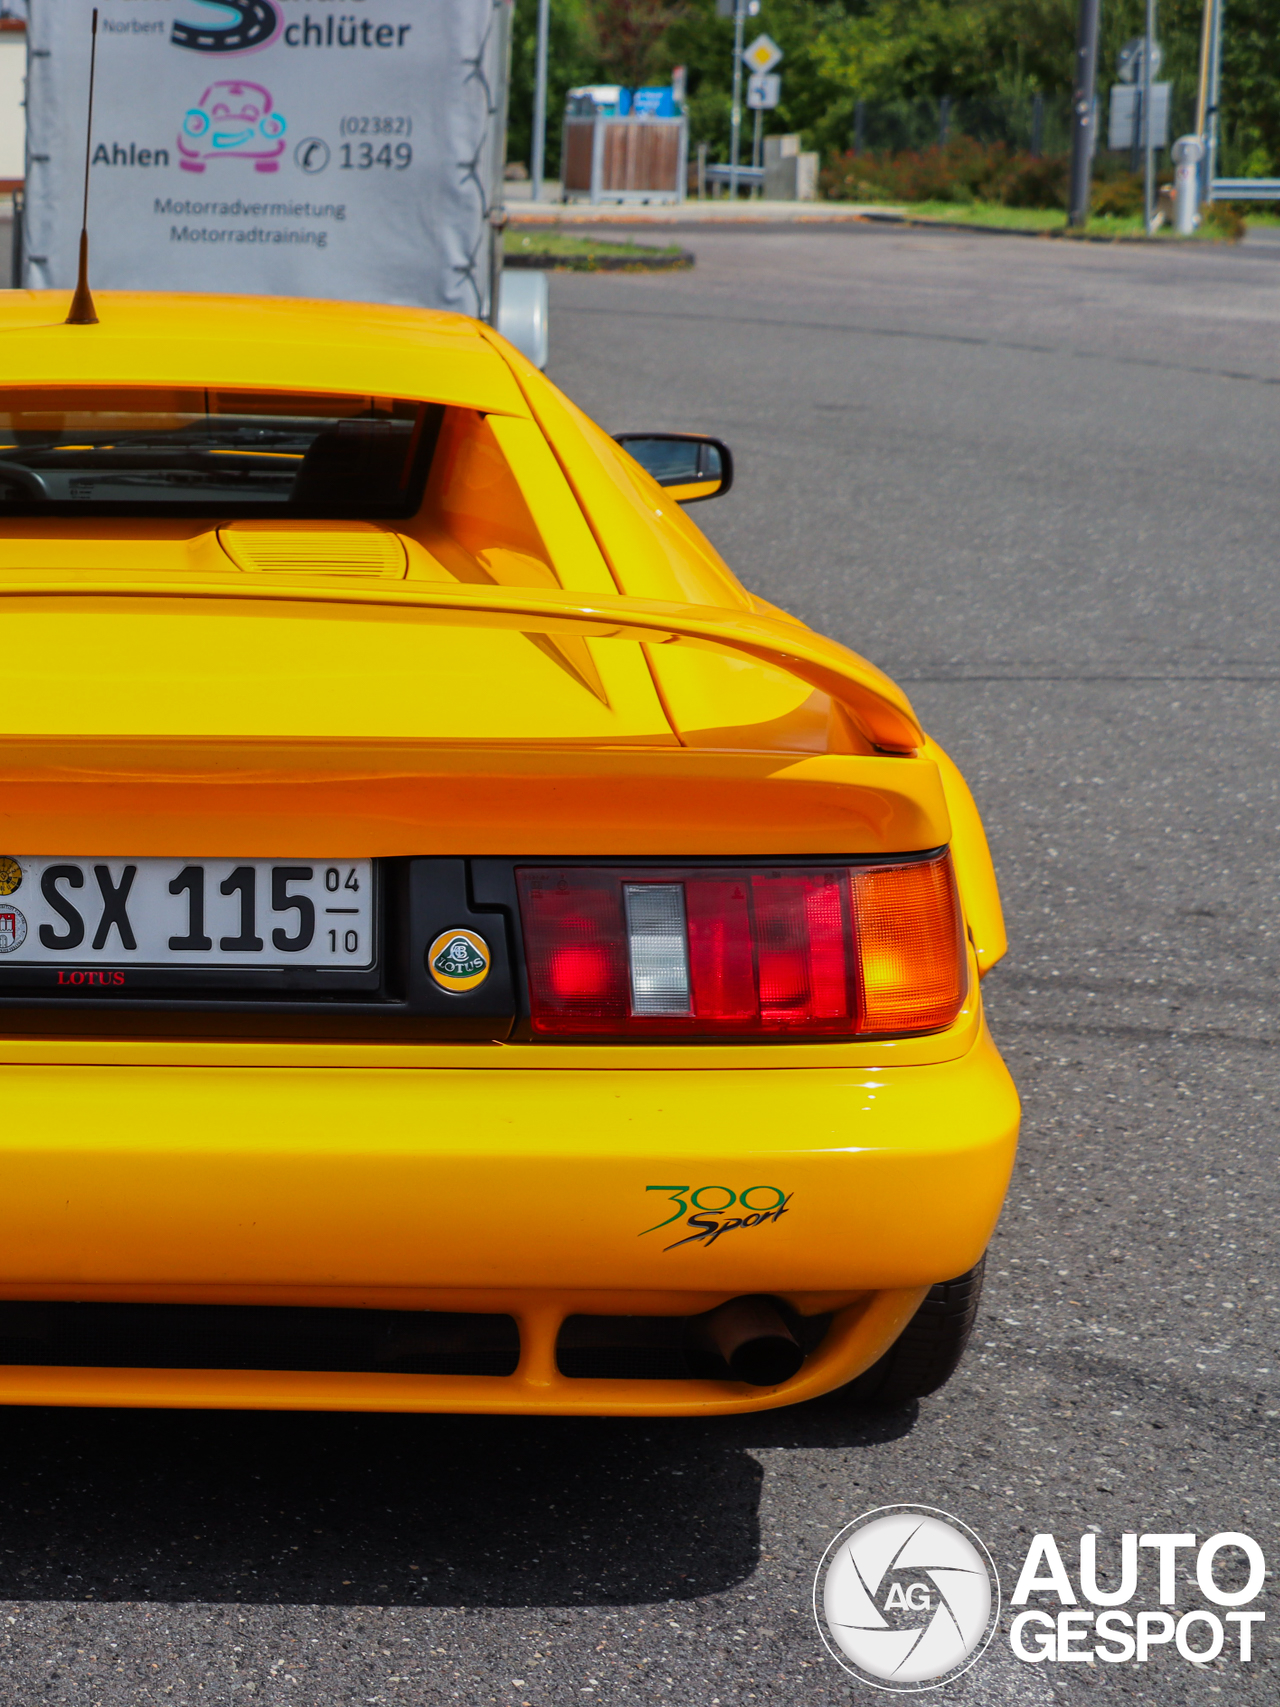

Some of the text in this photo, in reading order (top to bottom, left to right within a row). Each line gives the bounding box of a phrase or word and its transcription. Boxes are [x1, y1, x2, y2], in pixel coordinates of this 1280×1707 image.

[102, 18, 165, 34] Norbert
[339, 116, 413, 137] (02382)
[92, 143, 170, 167] Ahlen
[339, 142, 413, 170] 1349
[153, 199, 346, 221] Motorradvermietung
[170, 226, 328, 248] Motorradtraining
[325, 868, 360, 892] 04
[38, 865, 138, 950] SX
[168, 866, 315, 952] 115
[327, 929, 359, 953] 10
[437, 957, 483, 973] LOTUS
[57, 971, 125, 986] LOTUS
[637, 1185, 786, 1237] 300
[662, 1192, 795, 1253] Sport
